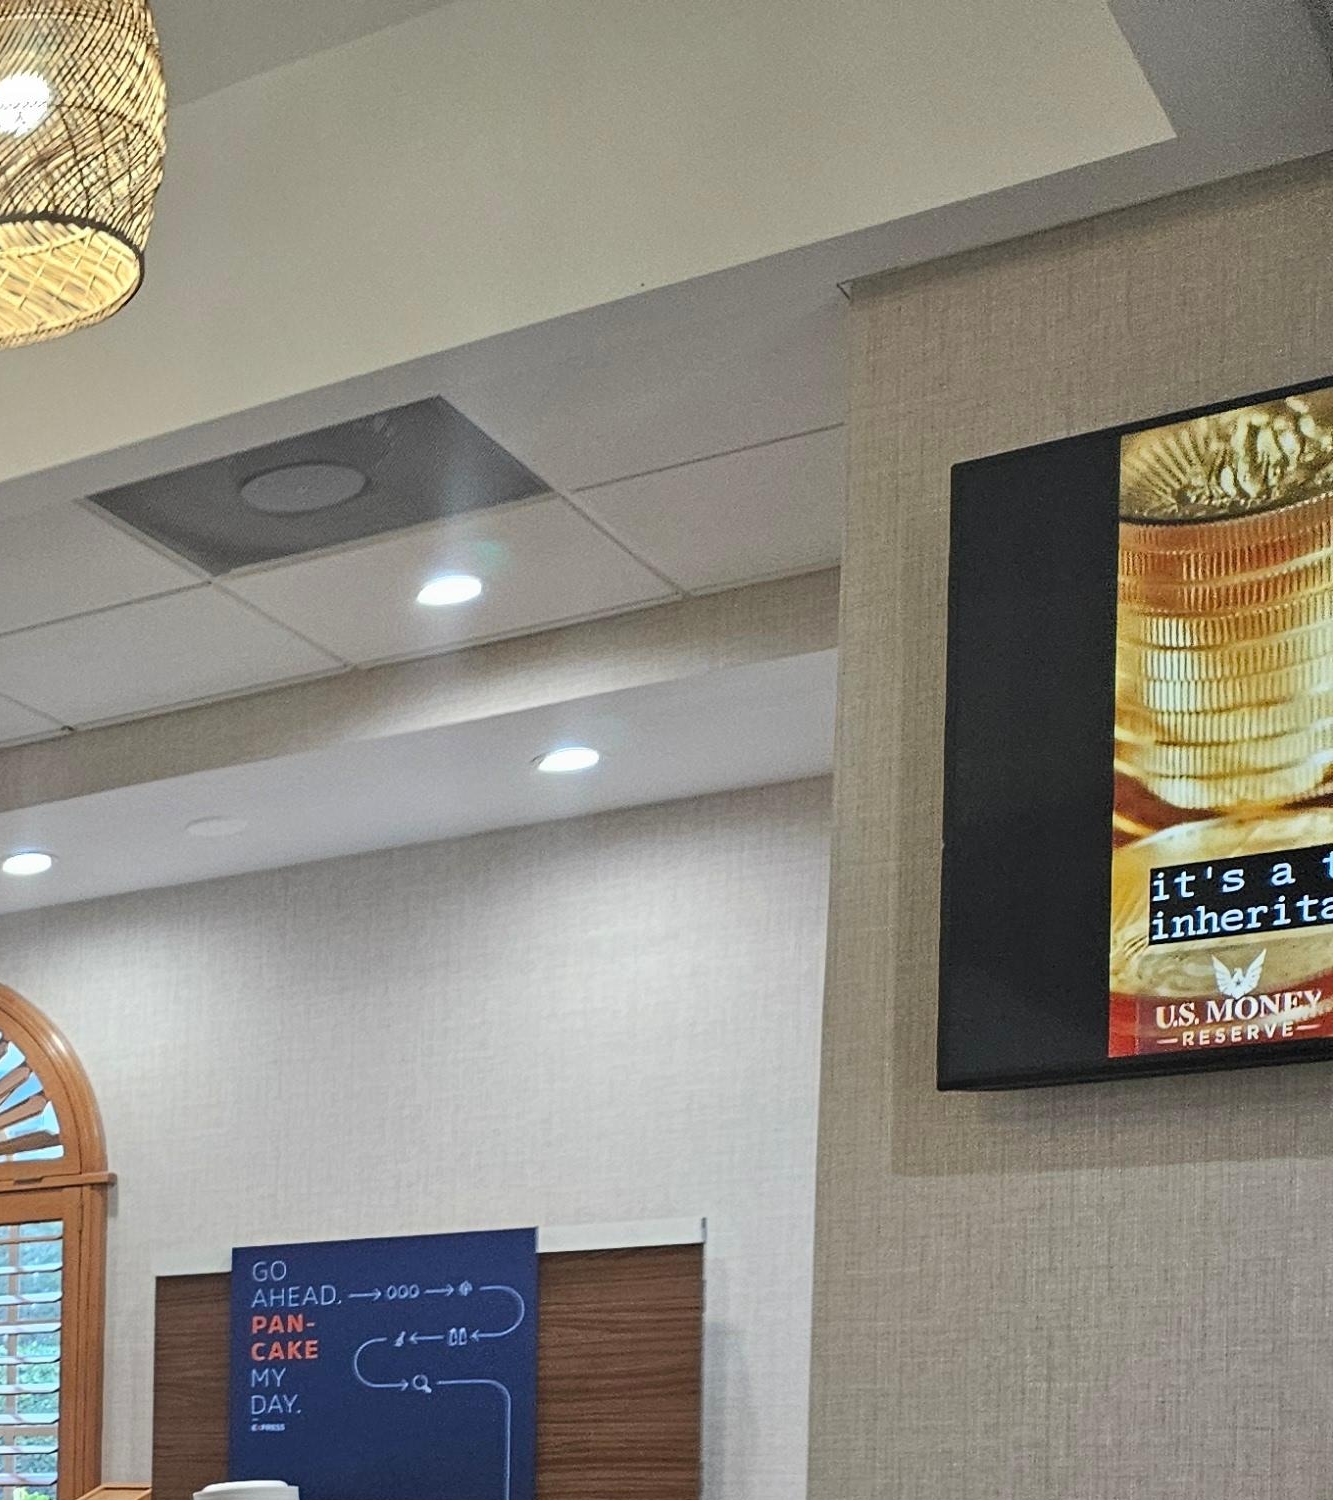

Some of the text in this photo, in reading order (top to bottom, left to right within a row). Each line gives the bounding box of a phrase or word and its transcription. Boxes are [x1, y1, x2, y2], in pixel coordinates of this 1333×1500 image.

[1152, 866, 1246, 902] it's
[1271, 861, 1296, 887] a
[1156, 988, 1322, 1029] U.S. MONEY
[1183, 1021, 1294, 1046] RESERVE
[252, 1260, 287, 1282] GO
[251, 1285, 343, 1308] AHEAD.
[251, 1313, 316, 1335] PAN-
[251, 1339, 319, 1362] CAKE
[250, 1367, 287, 1388] MY
[251, 1394, 302, 1415] DAY.
